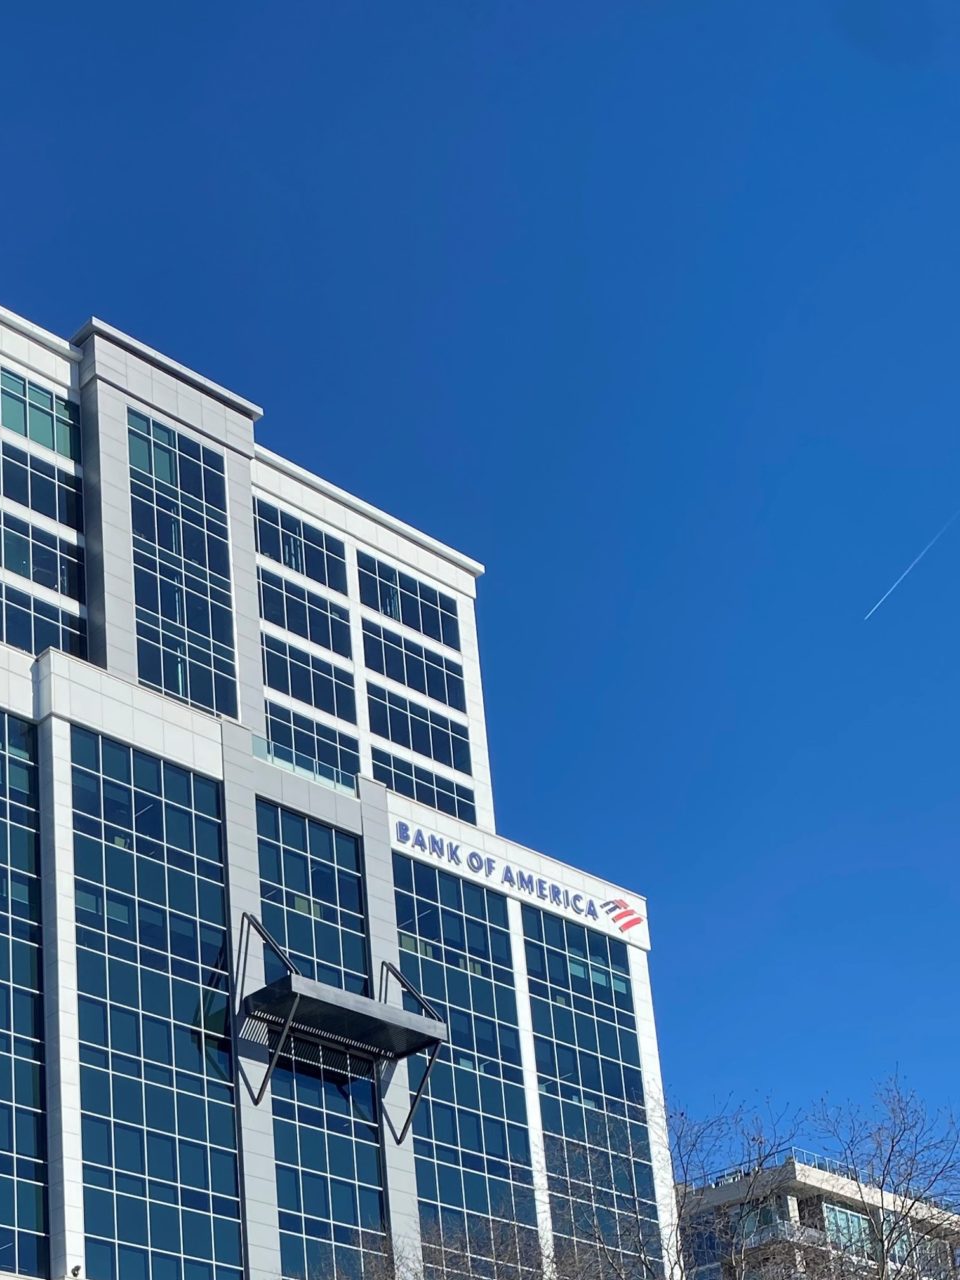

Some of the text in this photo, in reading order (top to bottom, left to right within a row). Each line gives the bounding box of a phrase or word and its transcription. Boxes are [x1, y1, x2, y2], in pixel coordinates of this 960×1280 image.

[396, 821, 599, 921] BANK OF AMERICA
